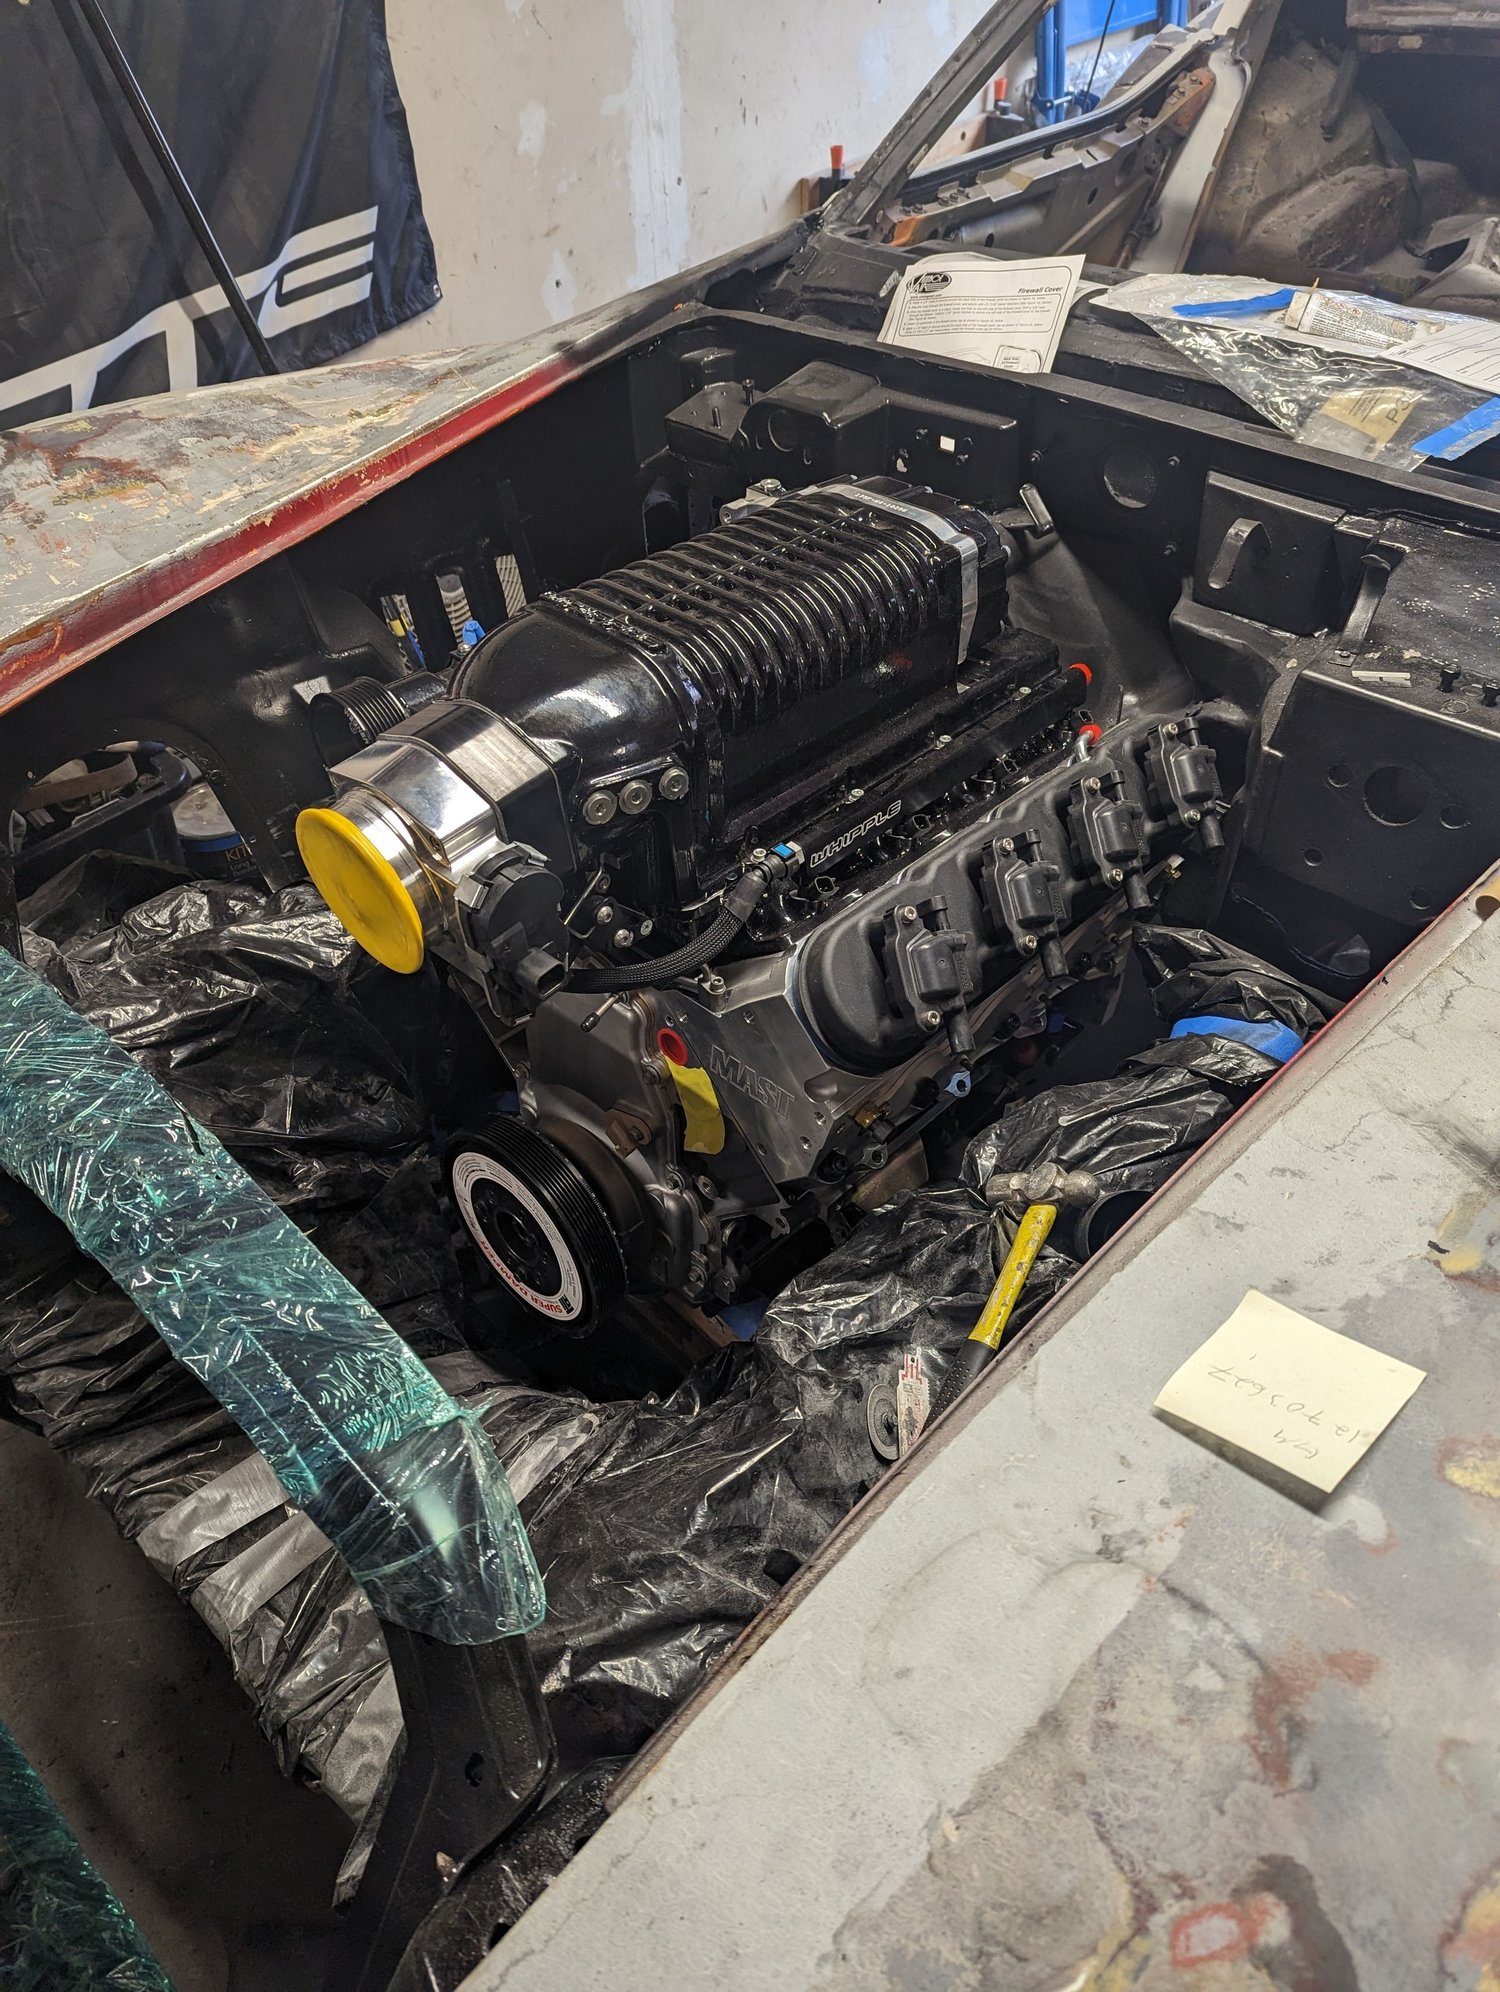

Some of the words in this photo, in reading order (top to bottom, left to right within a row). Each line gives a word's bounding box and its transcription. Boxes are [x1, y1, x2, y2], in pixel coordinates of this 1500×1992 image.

[809, 799, 902, 868] WHIPPLE
[710, 1043, 795, 1120] MAST
[480, 1239, 528, 1297] DAMPER
[530, 1294, 563, 1314] SUPER
